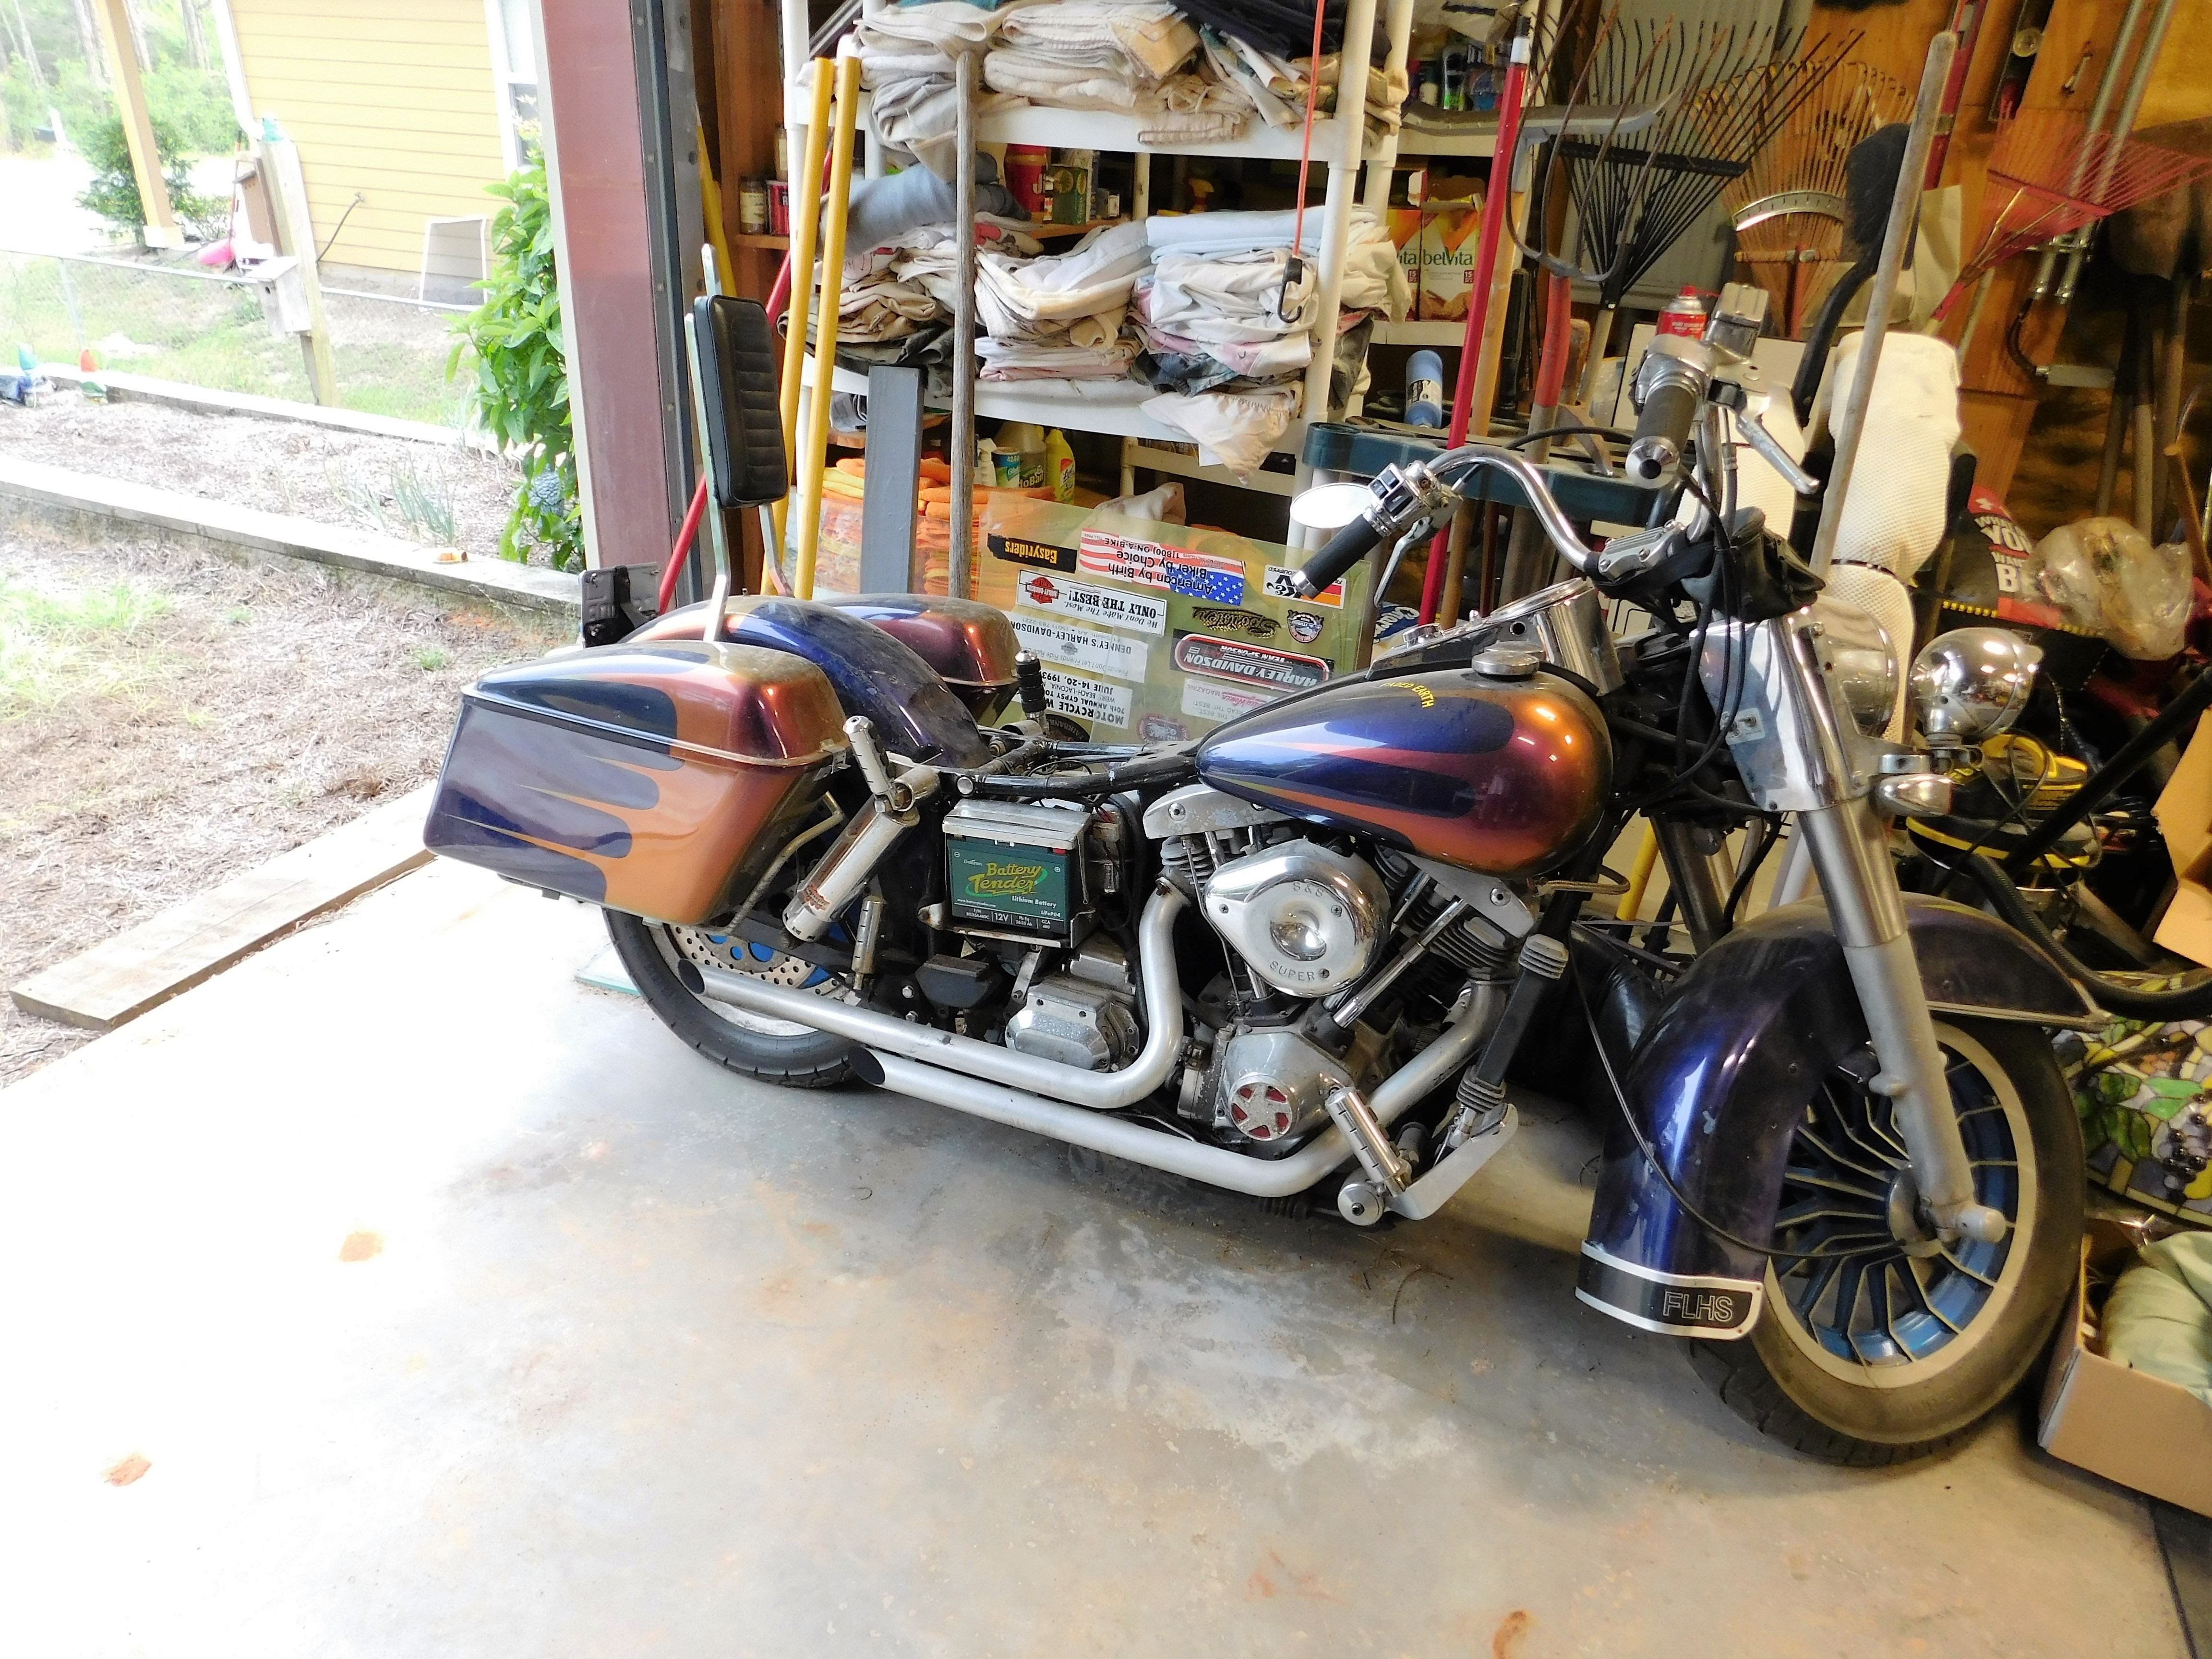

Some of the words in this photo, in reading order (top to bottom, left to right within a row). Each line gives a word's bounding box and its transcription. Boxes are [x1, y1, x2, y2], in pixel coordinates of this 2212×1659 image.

[1423, 247, 1473, 265] belVita
[1004, 540, 1058, 565] Easyriders
[1116, 551, 1155, 567] Choice
[1107, 563, 1134, 578] Birth
[1159, 557, 1173, 572] by
[1177, 563, 1207, 579] Biker
[1139, 565, 1153, 582] by
[1156, 573, 1214, 595] American
[1068, 590, 1099, 606] BEST!
[1102, 597, 1126, 611] THE
[1085, 606, 1100, 616] The
[1103, 610, 1123, 620] Make
[1129, 603, 1157, 619] ONLY
[1125, 614, 1145, 625] Don't
[1147, 620, 1158, 629] We
[1051, 623, 1069, 631] (501)
[1091, 638, 1131, 654] DENNEY'S
[1046, 652, 1058, 660] Ride
[1059, 654, 1081, 665] Friends
[1042, 672, 1060, 682] 1993
[1107, 666, 1128, 676] Friends
[1183, 652, 1317, 689] HARLEY-DAVIDSON
[1063, 675, 1090, 689] 14-20,
[1093, 684, 1114, 695] JUNE
[1187, 684, 1220, 697] MAGAZINE
[1411, 685, 1434, 708] EARTH
[1057, 692, 1078, 702] GYPSY
[1080, 697, 1107, 709] ANNUAL
[1192, 700, 1210, 708] BEST!
[1058, 701, 1124, 725] MOTORCYCLE
[1109, 705, 1125, 714] 70th
[1047, 719, 1084, 740] FAIRBANK
[986, 863, 1042, 878] Battery
[968, 874, 1035, 894] Tender
[1011, 895, 1034, 904] Lithium
[1034, 899, 1056, 909] Battery
[994, 912, 1009, 922] 12V
[1270, 960, 1315, 981] SUPER
[1662, 1288, 1734, 1322] FLHS
